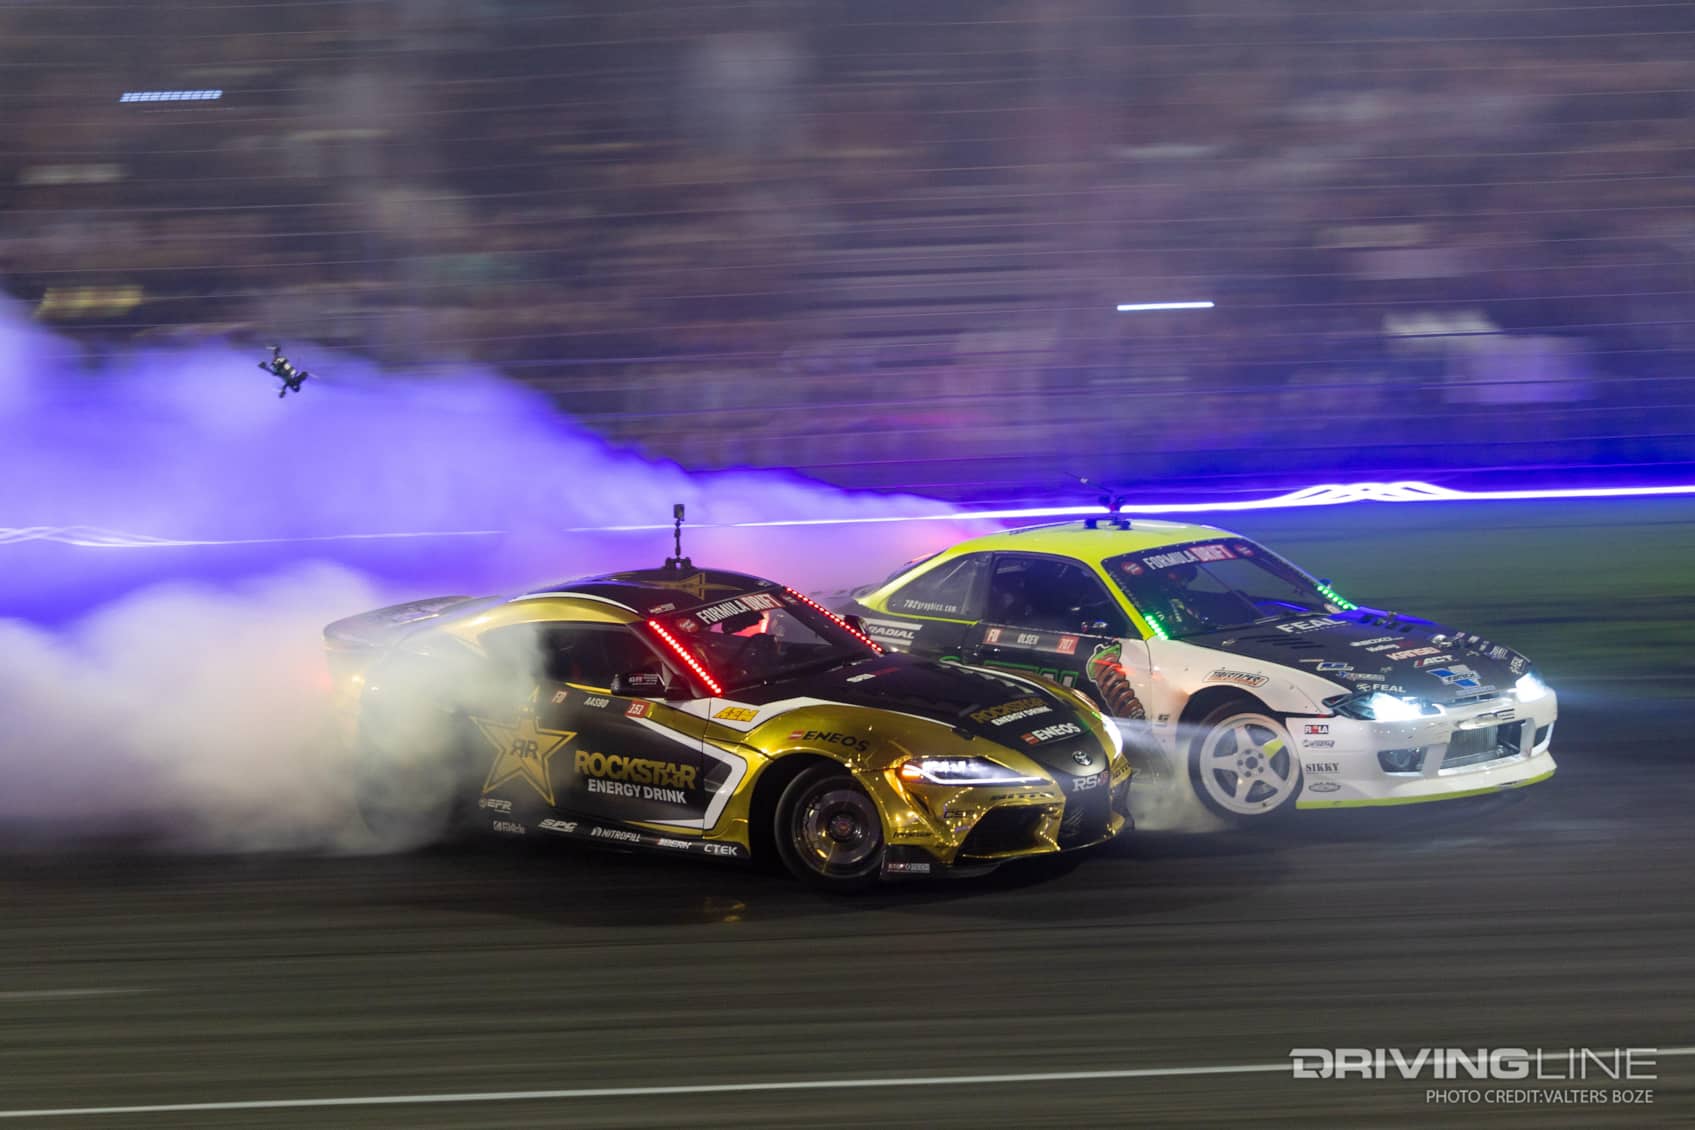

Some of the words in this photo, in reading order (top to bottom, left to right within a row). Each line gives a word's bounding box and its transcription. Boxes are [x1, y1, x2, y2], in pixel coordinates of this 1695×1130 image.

[1143, 549, 1200, 570] FORMULA
[696, 599, 751, 625] FORMULA
[1276, 618, 1348, 634] FEAL
[1372, 683, 1407, 694] FEAL
[802, 730, 870, 753] ENEOS
[1032, 722, 1081, 742] ENEOS
[574, 750, 697, 789] ROCKSTAR
[1305, 762, 1340, 772] SIKKY
[587, 778, 642, 798] ENERGY
[643, 787, 688, 804] DRINK
[601, 829, 641, 842] NITROFILL
[703, 843, 738, 856] CTEK
